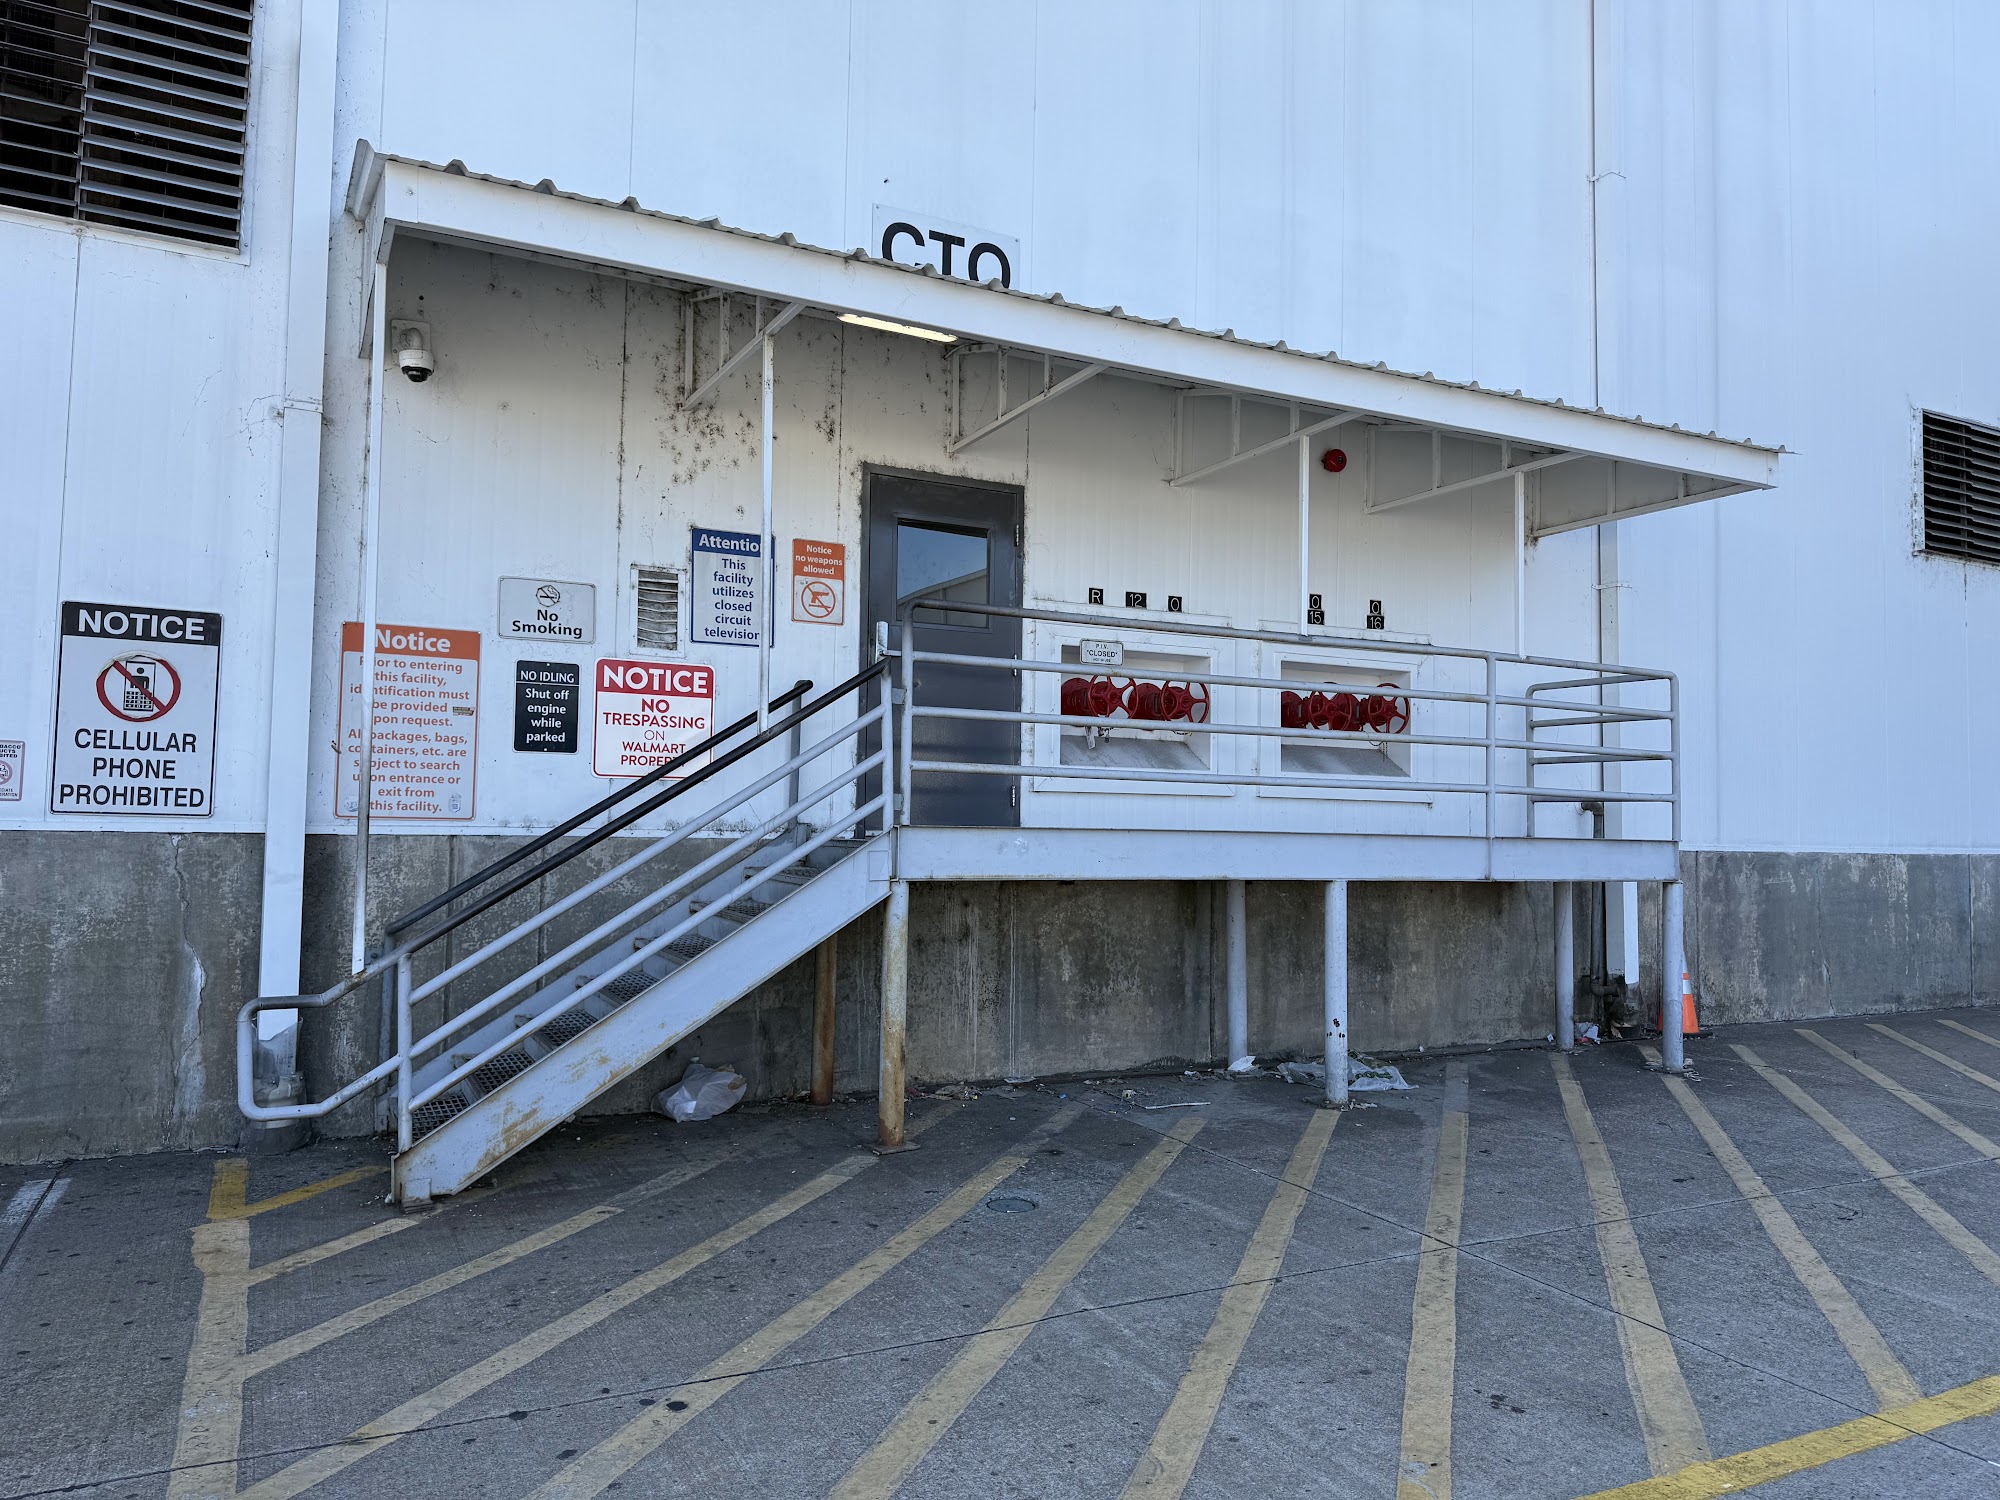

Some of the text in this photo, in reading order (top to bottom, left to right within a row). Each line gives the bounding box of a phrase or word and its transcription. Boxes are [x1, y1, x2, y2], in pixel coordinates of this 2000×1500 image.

[699, 534, 760, 552] Attentio
[807, 545, 832, 554] Notice
[722, 559, 745, 570] This
[808, 556, 842, 565] weapons
[803, 565, 834, 574] allowed
[714, 571, 753, 587] facility
[713, 586, 754, 598] utilizes
[1092, 590, 1100, 603] R
[715, 600, 752, 611] closed
[1130, 594, 1142, 607] 12
[537, 610, 558, 621] No
[715, 614, 751, 625] circuit
[1310, 611, 1321, 624] 15
[78, 609, 205, 640] NOTICE
[1370, 617, 1381, 629] 16
[512, 620, 582, 639] Smoking
[375, 629, 450, 652] Notice
[360, 656, 462, 674] Pior to entering
[375, 671, 446, 686] this facility,
[520, 671, 574, 682] NO IDLING
[604, 665, 707, 693] NOTICE
[350, 684, 469, 699] idntification must
[526, 688, 569, 700] Shut off
[373, 701, 387, 709] be
[391, 702, 447, 712] provided
[527, 704, 566, 715] engine
[642, 698, 670, 713] NO
[374, 715, 452, 727] pon request.
[531, 717, 561, 728] while
[603, 712, 705, 729] TRESPASSING
[75, 728, 196, 752] CELLULAR
[348, 729, 361, 738] Al
[435, 733, 467, 745] bags,
[526, 732, 565, 743] parked
[644, 730, 664, 741] ON
[348, 744, 418, 756] cotainers,
[422, 748, 444, 756] etc.
[623, 742, 685, 753] WALMART
[354, 758, 460, 770] sject to search
[621, 755, 684, 767] PROPER
[93, 758, 176, 779] PHONE
[390, 774, 444, 784] entrance
[60, 784, 204, 807] PROHIBITED
[378, 787, 434, 797] exit from
[370, 801, 441, 813] this facility.
